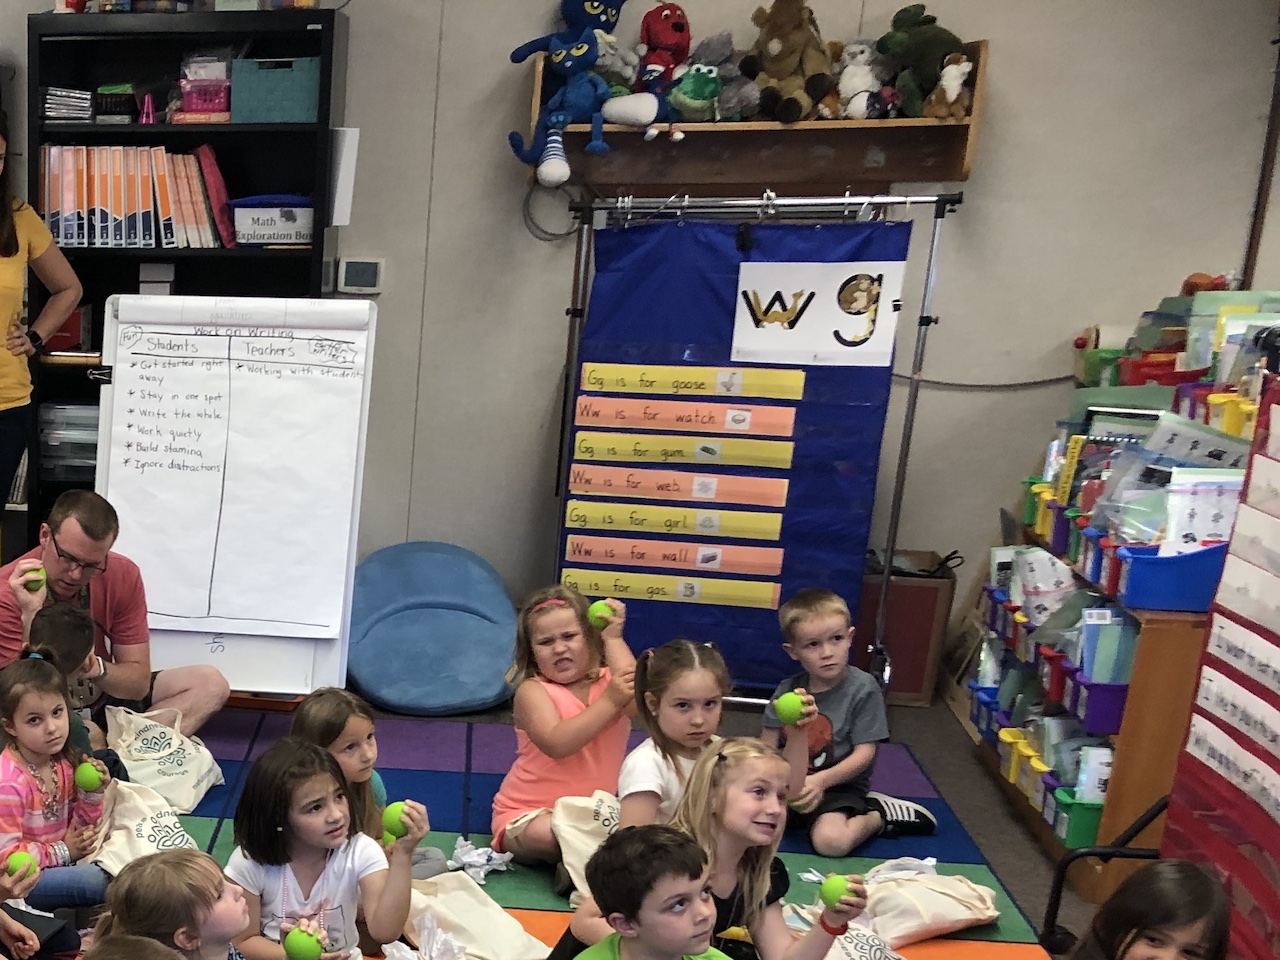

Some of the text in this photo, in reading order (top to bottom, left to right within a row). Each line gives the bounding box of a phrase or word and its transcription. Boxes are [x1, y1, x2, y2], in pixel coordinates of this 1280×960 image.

[252, 217, 276, 226] Math
[236, 231, 292, 242] Exploration
[741, 273, 884, 347] w g
[123, 331, 137, 342] Fun
[194, 327, 294, 342] Work on Writing
[147, 338, 295, 357] Students Teachers
[140, 359, 158, 370] Get
[162, 360, 194, 368] started
[247, 365, 282, 379] Working
[290, 367, 313, 375] with
[139, 375, 164, 386] away
[588, 370, 706, 394] Gg is for goose
[140, 390, 163, 403] Stay
[204, 392, 223, 405] spot
[139, 408, 222, 419] Write the whole
[579, 404, 600, 418] Ww
[615, 410, 626, 420] is
[643, 406, 660, 420] for
[137, 424, 202, 442] Work quietly
[136, 442, 203, 458] Build stamina
[579, 439, 595, 458] Gg
[607, 446, 617, 456] is
[633, 442, 649, 457] for
[135, 459, 221, 474] Ignore distractions
[572, 470, 593, 485] Ww
[604, 478, 613, 487] is
[626, 473, 642, 489] for
[570, 508, 688, 532] Gg is for girl
[571, 542, 689, 563] Ww is for wall
[589, 583, 600, 591] is
[613, 579, 631, 593] for
